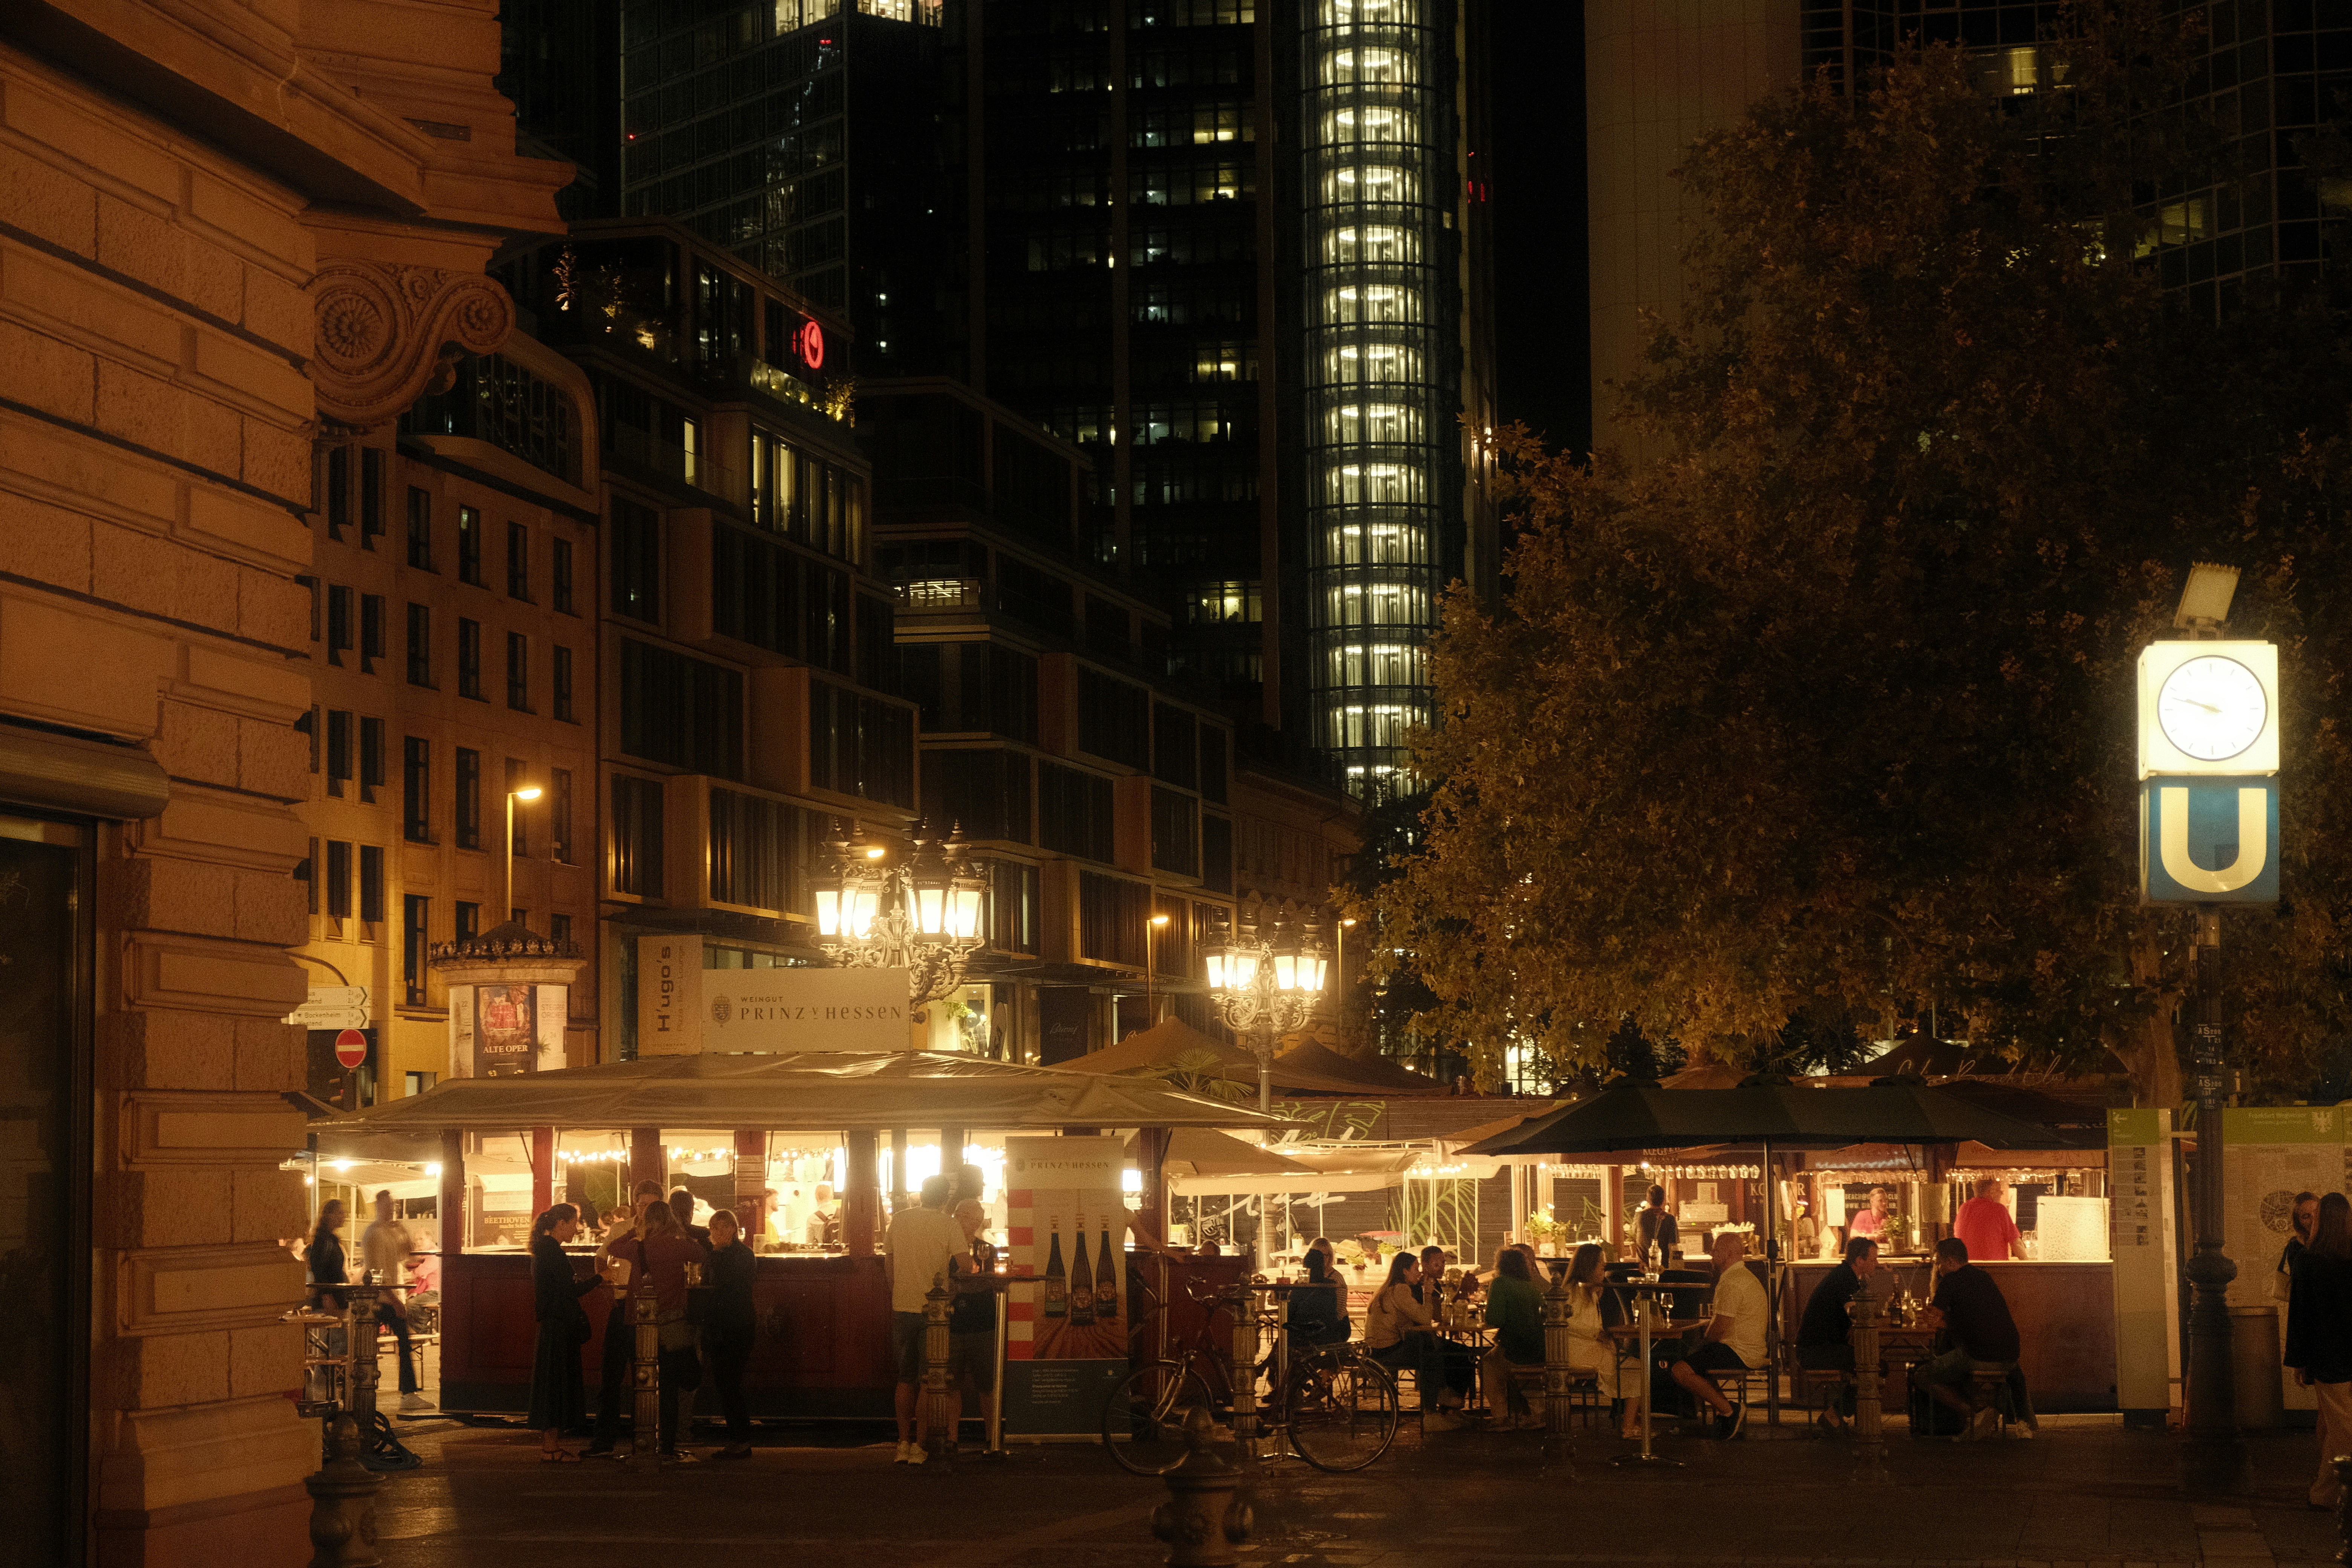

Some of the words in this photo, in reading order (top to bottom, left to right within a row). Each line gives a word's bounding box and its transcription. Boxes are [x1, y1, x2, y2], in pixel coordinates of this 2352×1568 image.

[2161, 787, 2267, 893] U
[656, 946, 674, 1032] H'ugo's
[740, 1007, 805, 1020] PRINZ
[483, 1045, 504, 1054] ALTE
